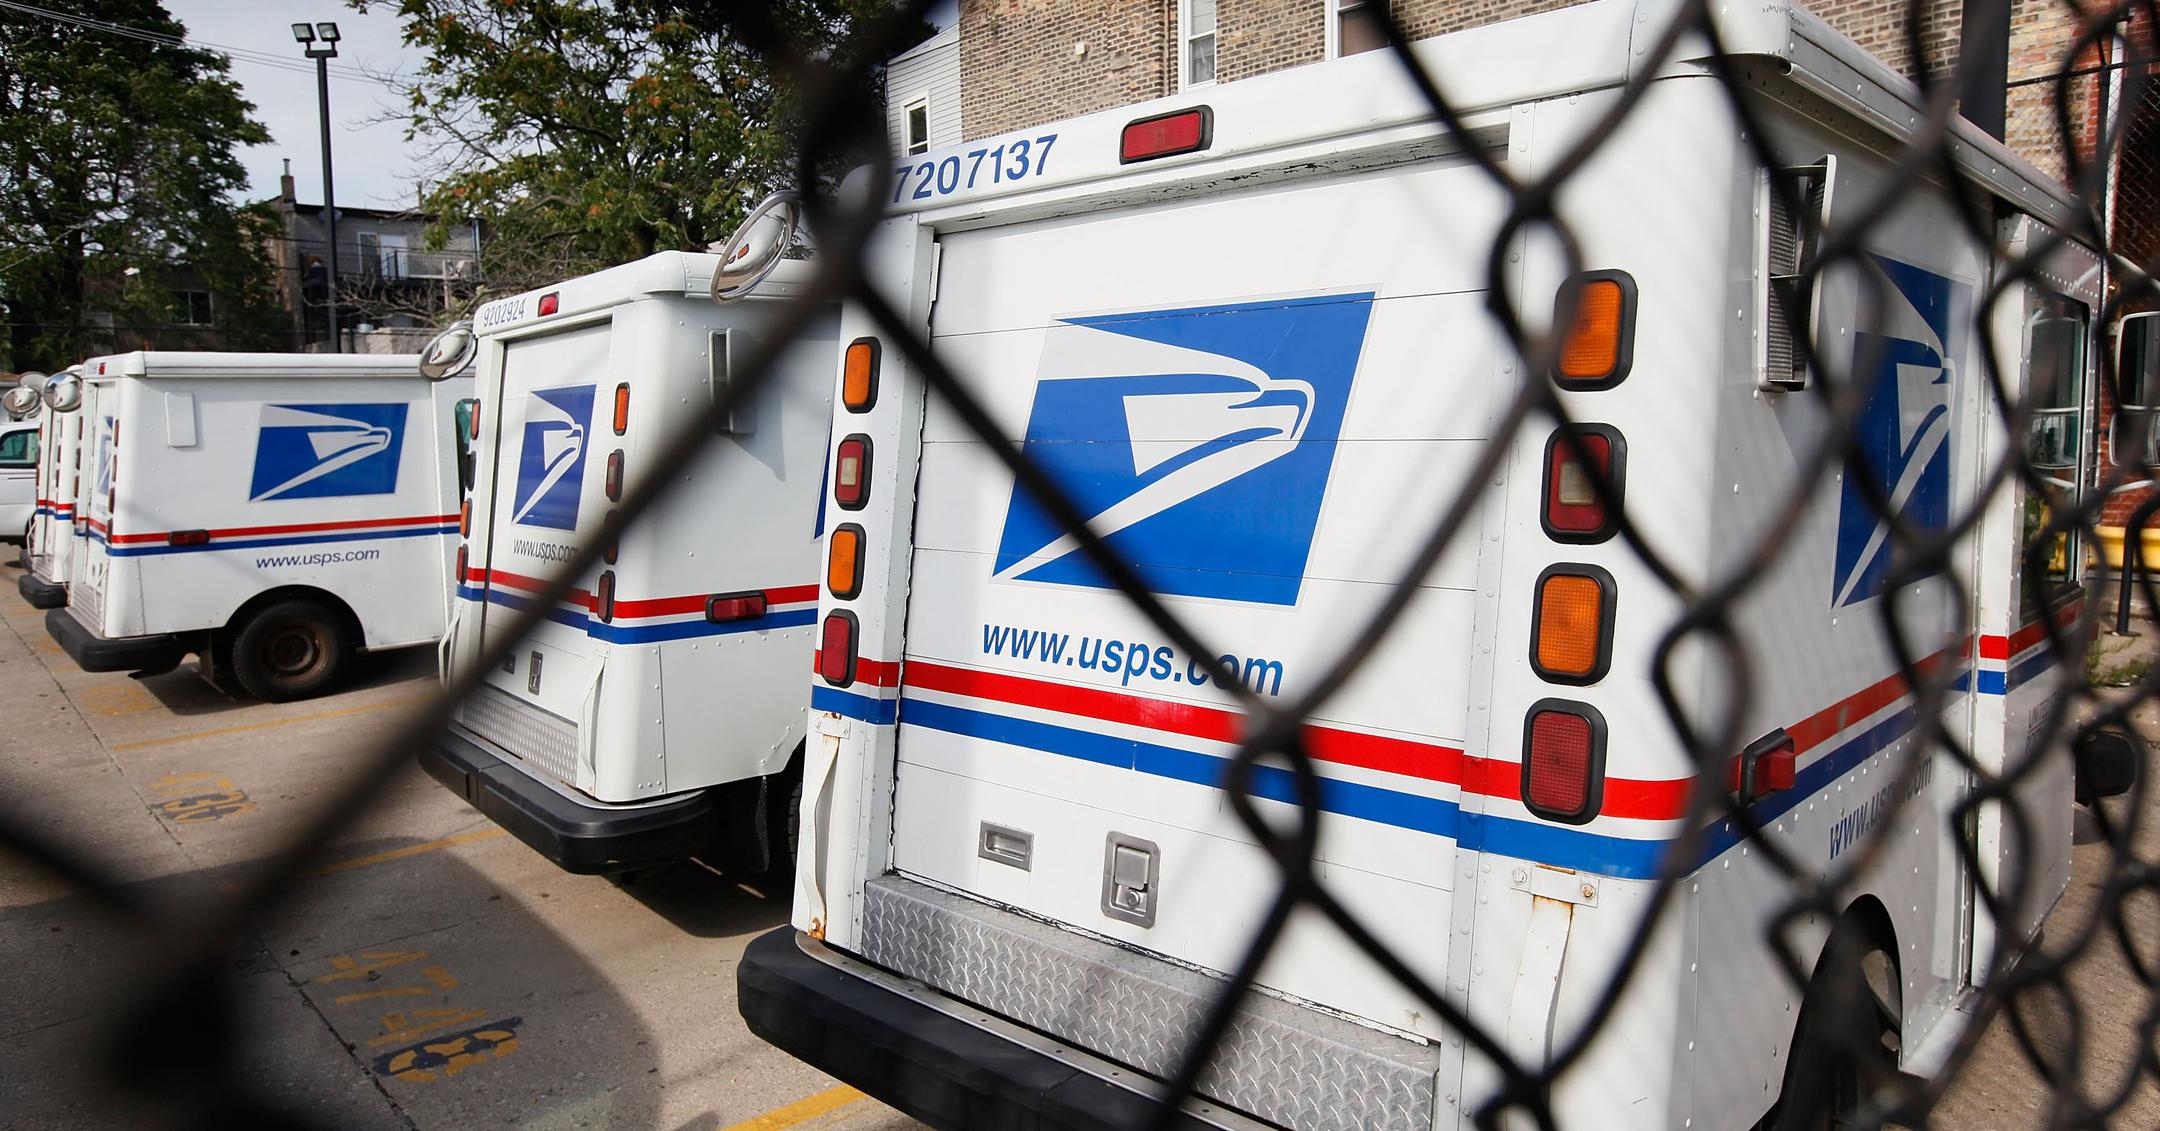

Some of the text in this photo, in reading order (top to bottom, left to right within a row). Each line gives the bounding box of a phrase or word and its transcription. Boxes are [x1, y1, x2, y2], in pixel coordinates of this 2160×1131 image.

[892, 134, 1058, 203] 7207137
[483, 298, 527, 327] 9202924
[256, 549, 380, 568] www.usps.com
[983, 624, 1283, 696] www.usps.com
